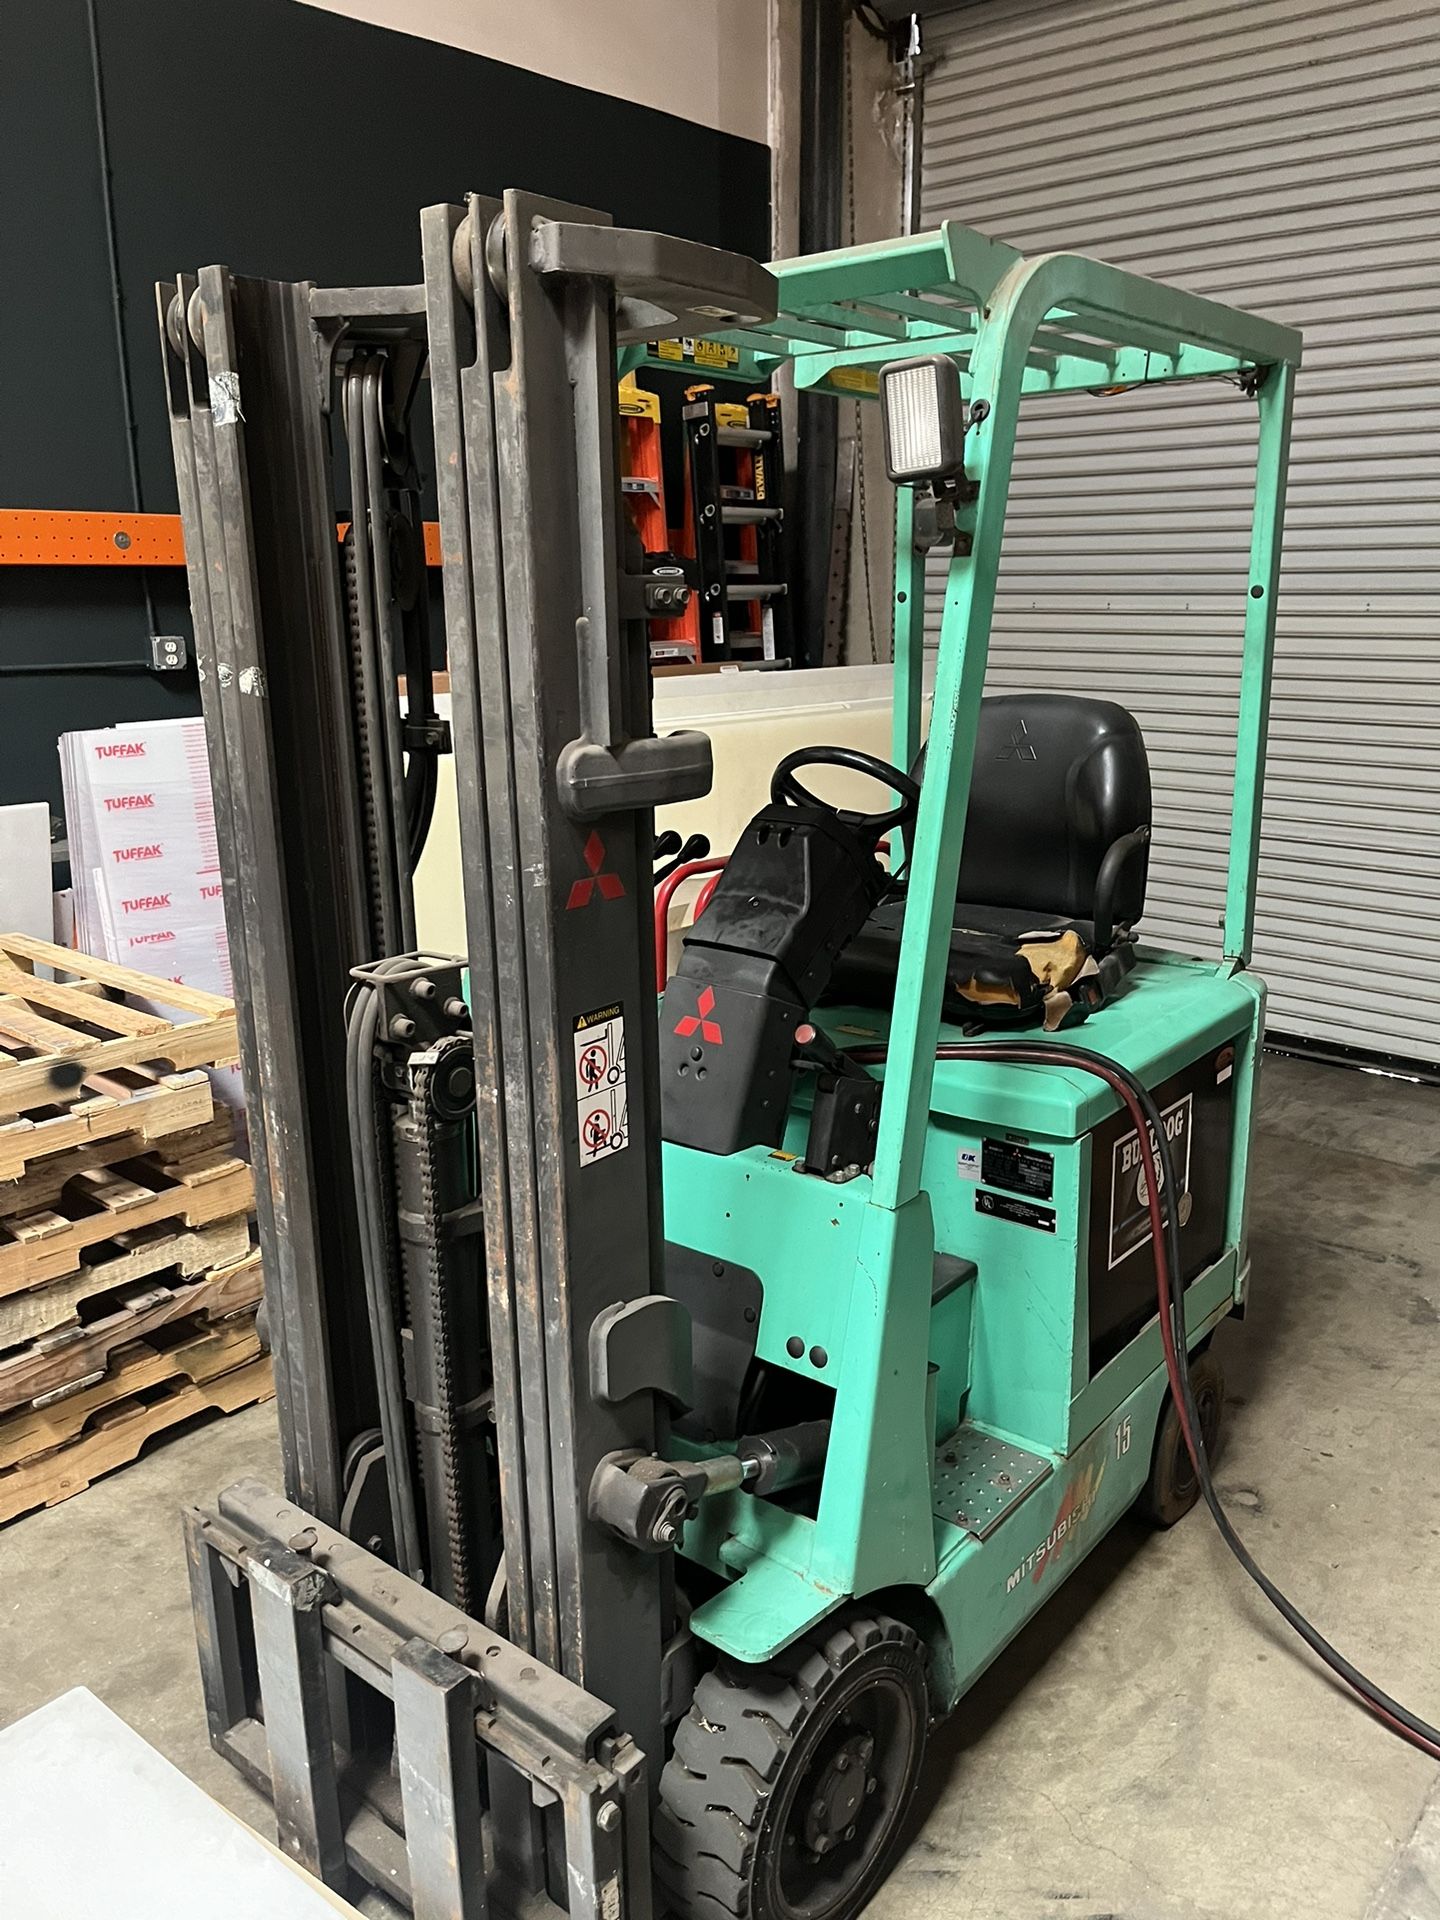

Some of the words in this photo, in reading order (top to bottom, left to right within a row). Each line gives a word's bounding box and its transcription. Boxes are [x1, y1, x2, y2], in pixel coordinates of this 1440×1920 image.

[95, 742, 145, 760] TUFFAK
[104, 794, 154, 811] TUFFAK
[113, 845, 163, 862] TUFFAK
[121, 895, 171, 913] TUFFAK
[587, 1006, 620, 1023] WARNING
[1121, 1109, 1184, 1174] BULOG
[1115, 1415, 1131, 1460] 15
[1007, 1491, 1096, 1593] MITSUBISHI
